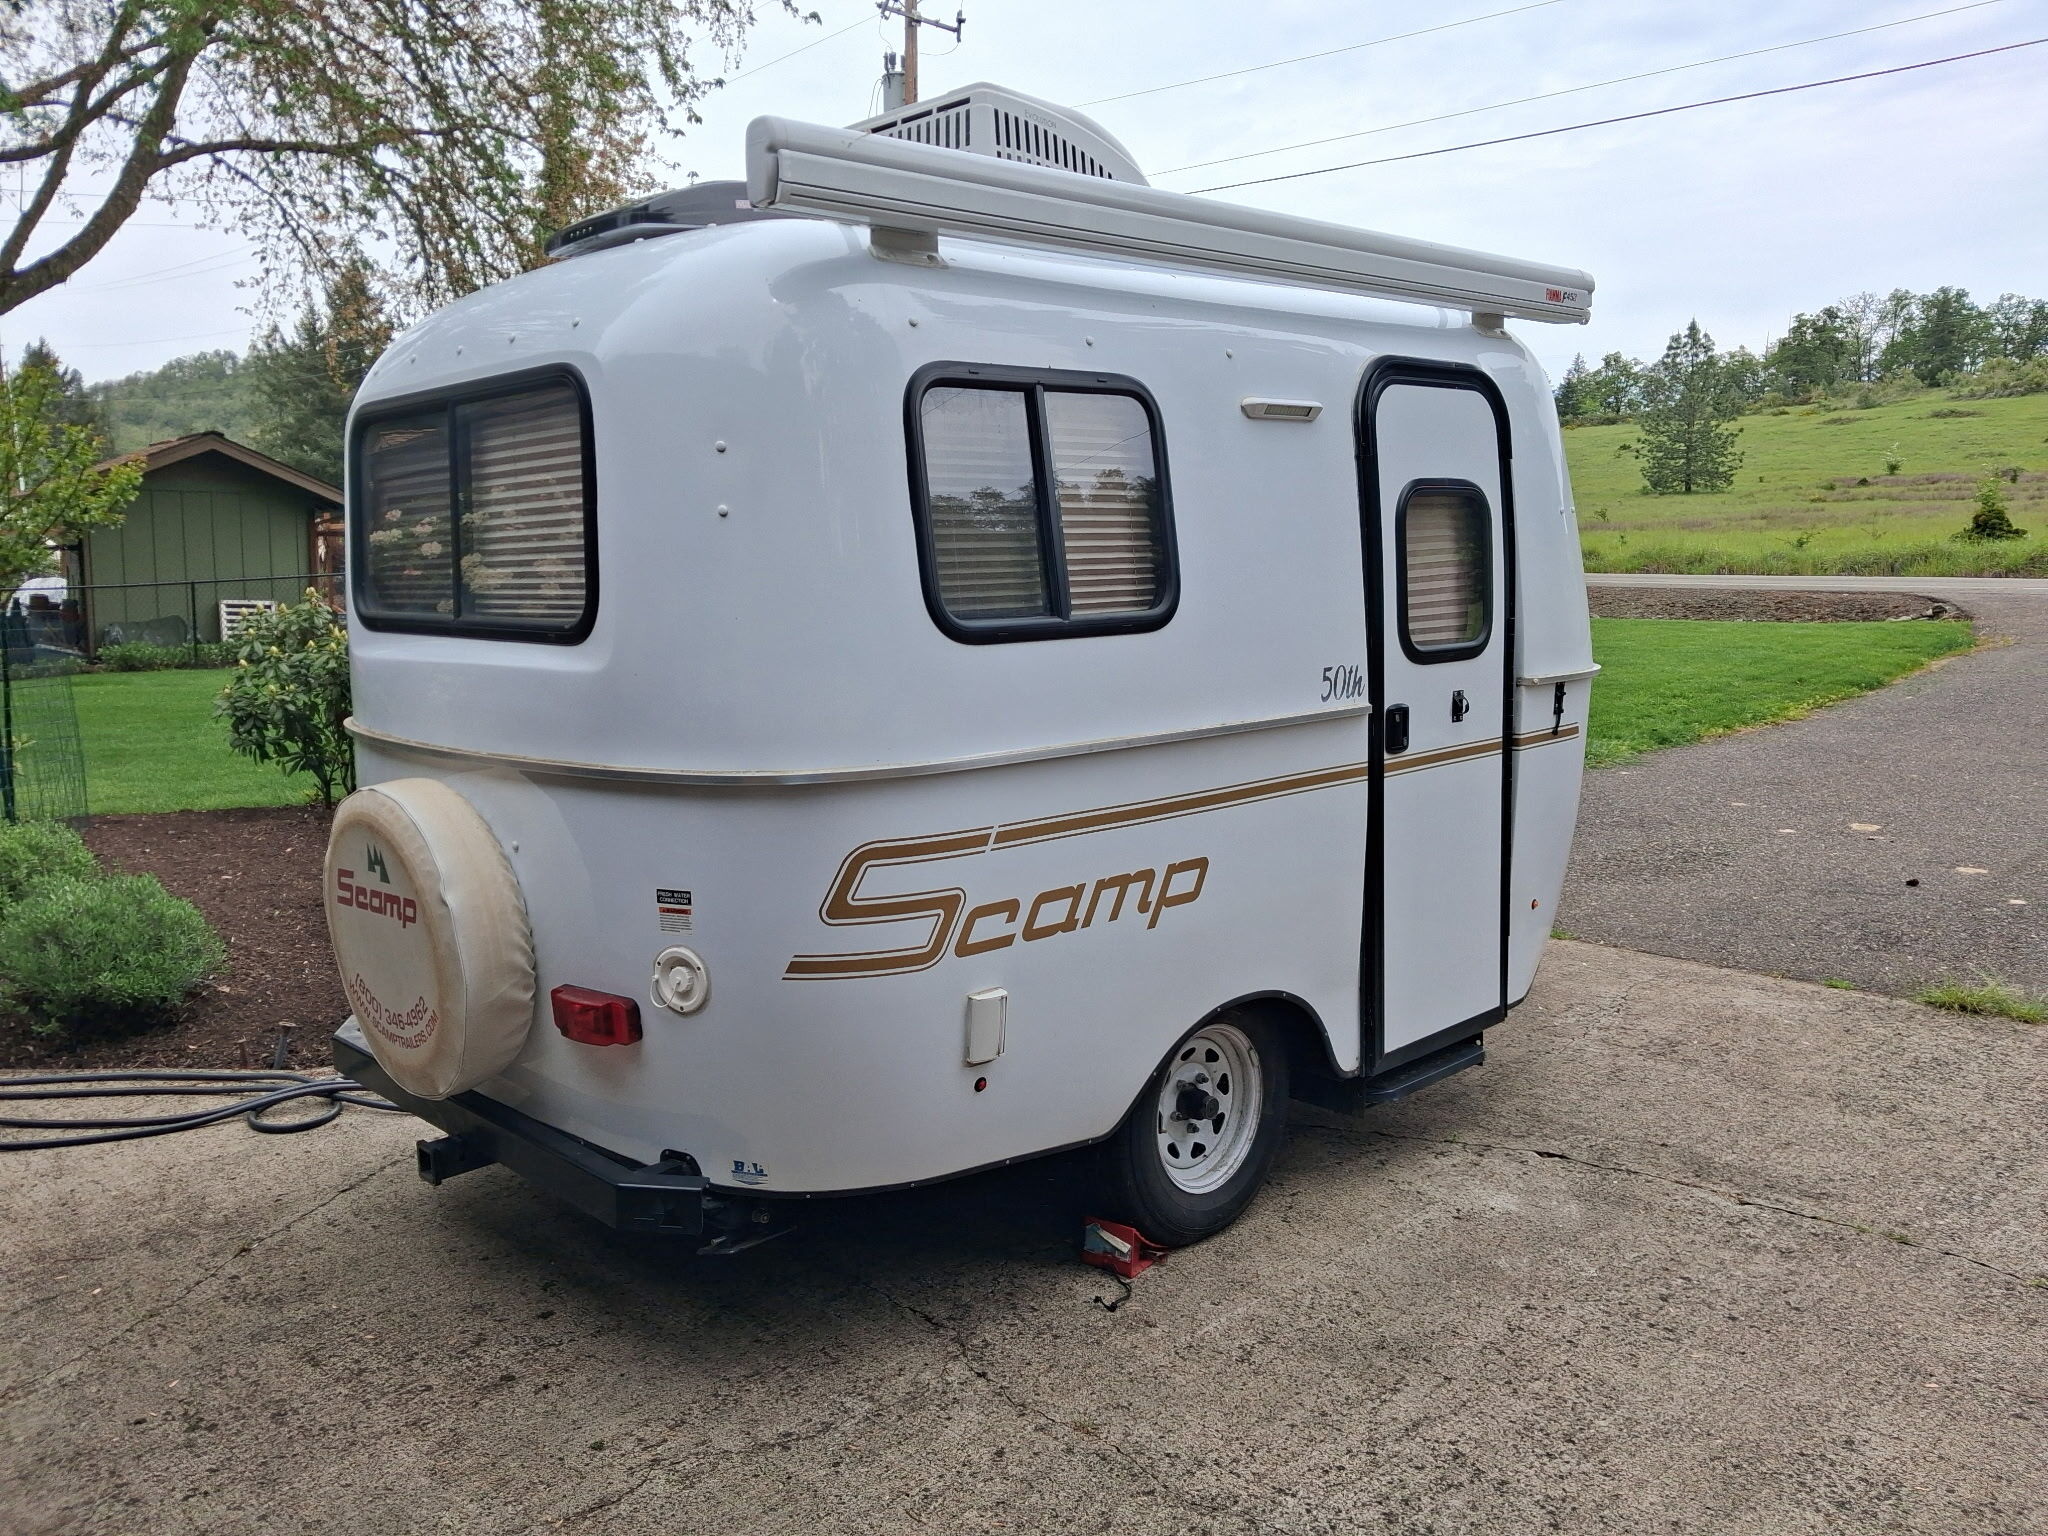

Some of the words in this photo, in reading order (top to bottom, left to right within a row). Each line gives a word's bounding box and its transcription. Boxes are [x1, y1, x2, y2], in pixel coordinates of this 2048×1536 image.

[1320, 664, 1366, 703] 50th
[337, 868, 417, 929] Scamp
[657, 890, 673, 898] FRESH
[659, 896, 689, 905] CONNECTION
[781, 825, 1210, 981] Scamp
[355, 973, 382, 1021] (800)
[384, 996, 429, 1031] 346-4962
